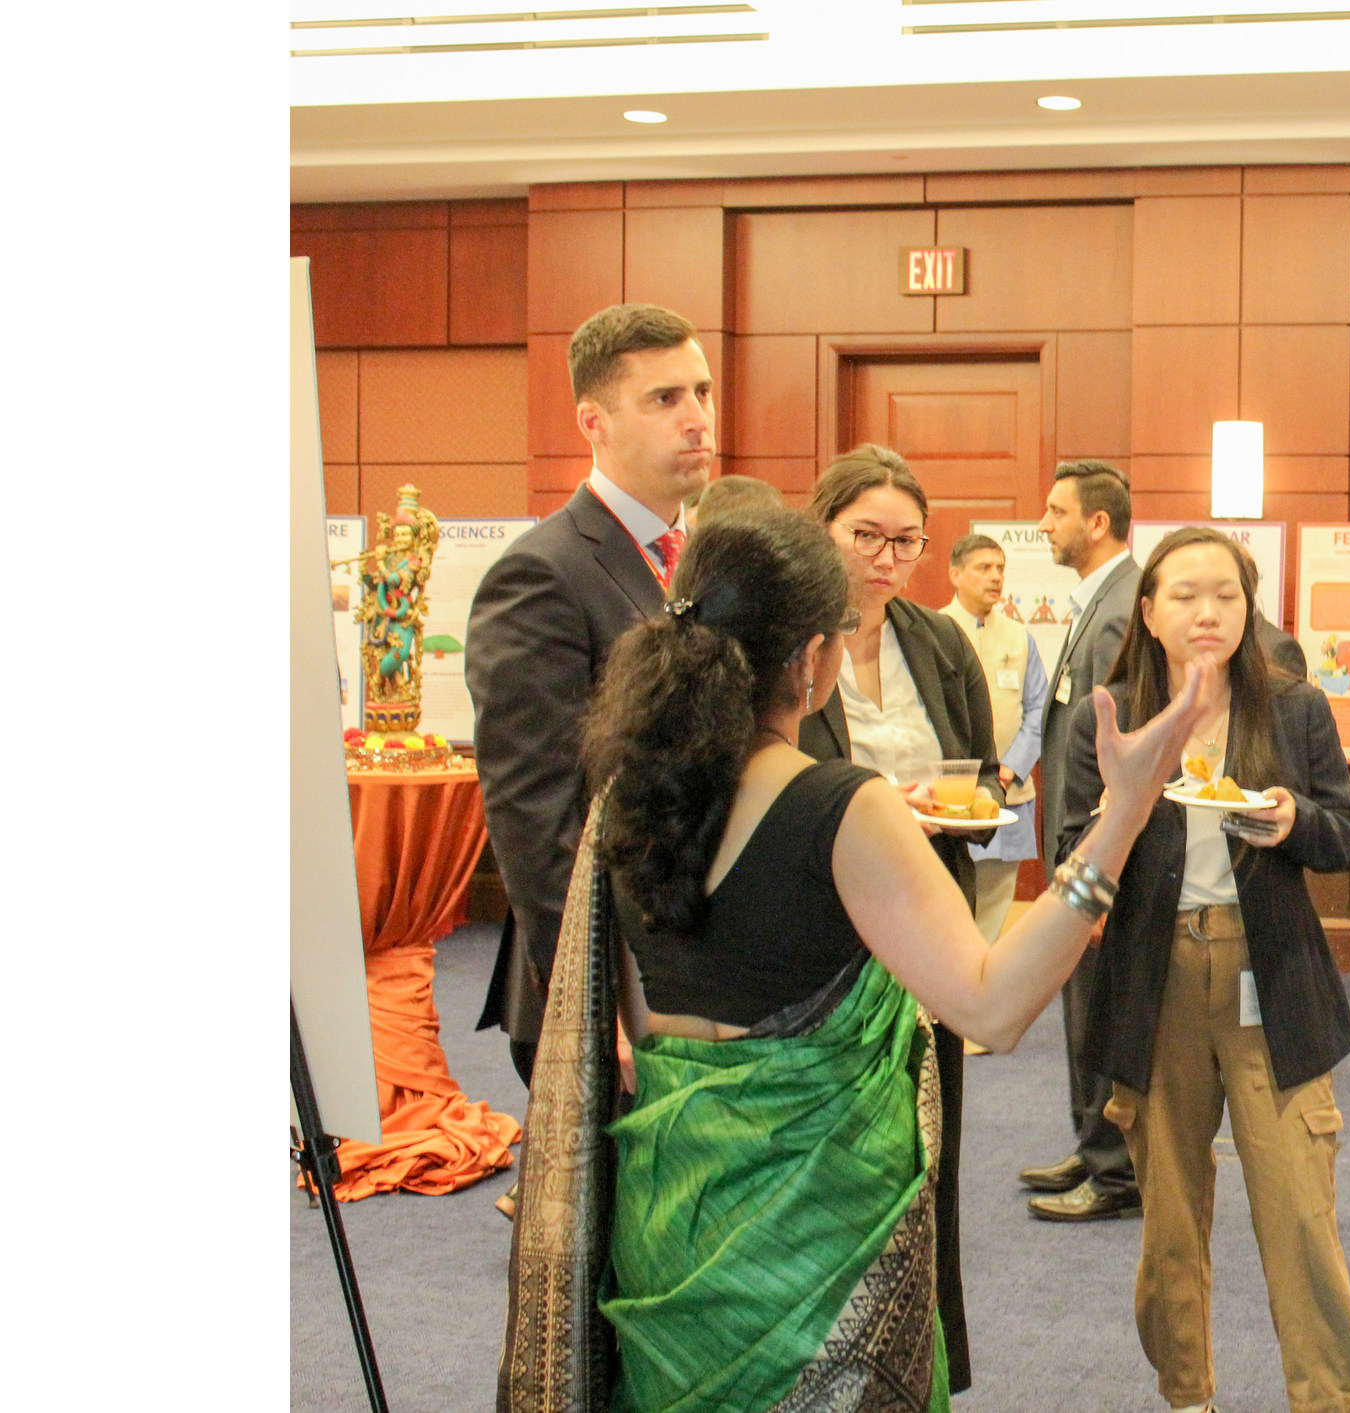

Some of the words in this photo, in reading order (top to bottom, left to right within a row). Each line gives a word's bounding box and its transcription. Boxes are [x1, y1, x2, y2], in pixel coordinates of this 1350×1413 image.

[907, 250, 957, 291] EXIT
[439, 526, 505, 539] SCIENCES
[1001, 529, 1045, 543] AYUR
